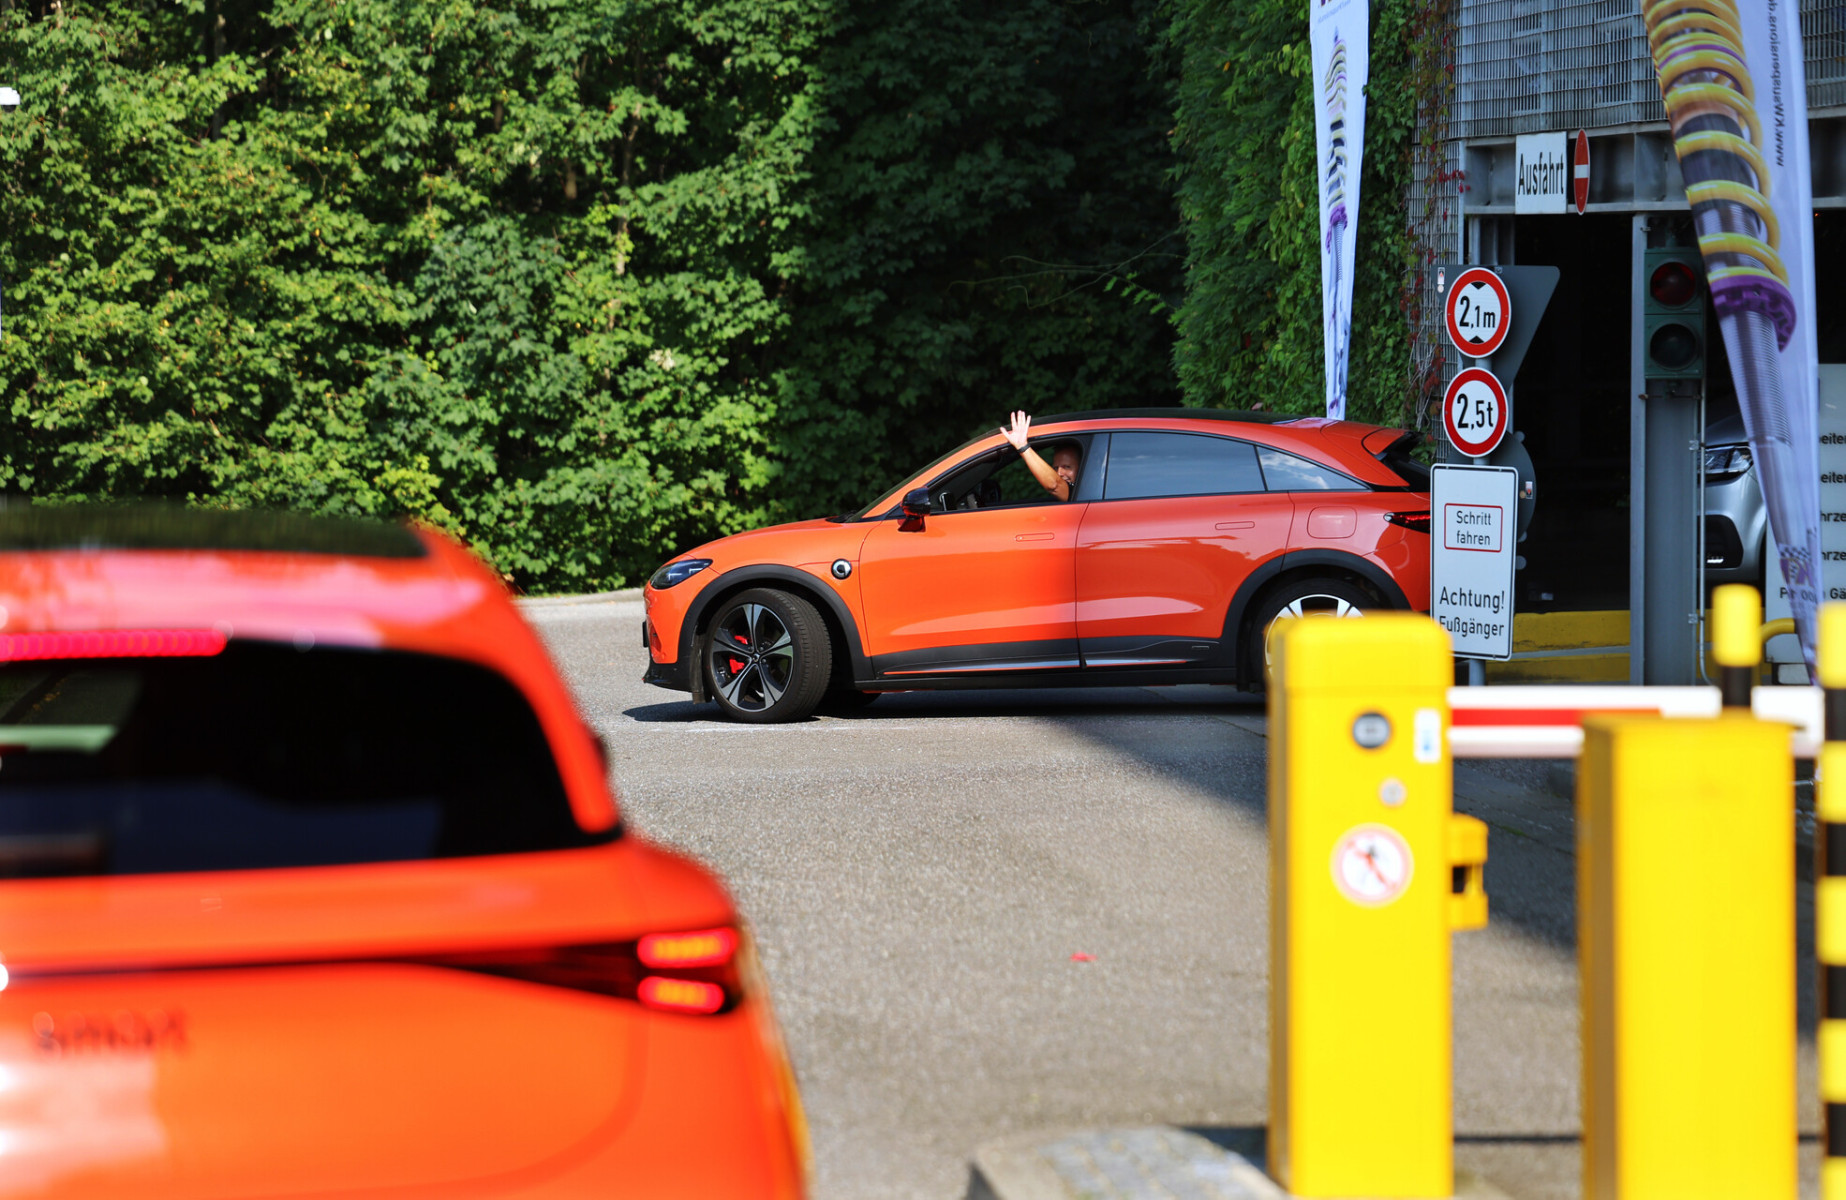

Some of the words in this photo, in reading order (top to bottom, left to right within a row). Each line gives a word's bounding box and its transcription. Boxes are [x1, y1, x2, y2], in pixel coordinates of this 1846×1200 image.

[1517, 151, 1565, 196] Ausfahrt
[1456, 510, 1492, 526] Schritt
[1456, 530, 1491, 546] fahren
[1439, 586, 1505, 614] Achtung!
[1439, 615, 1505, 640] Fußgänger
